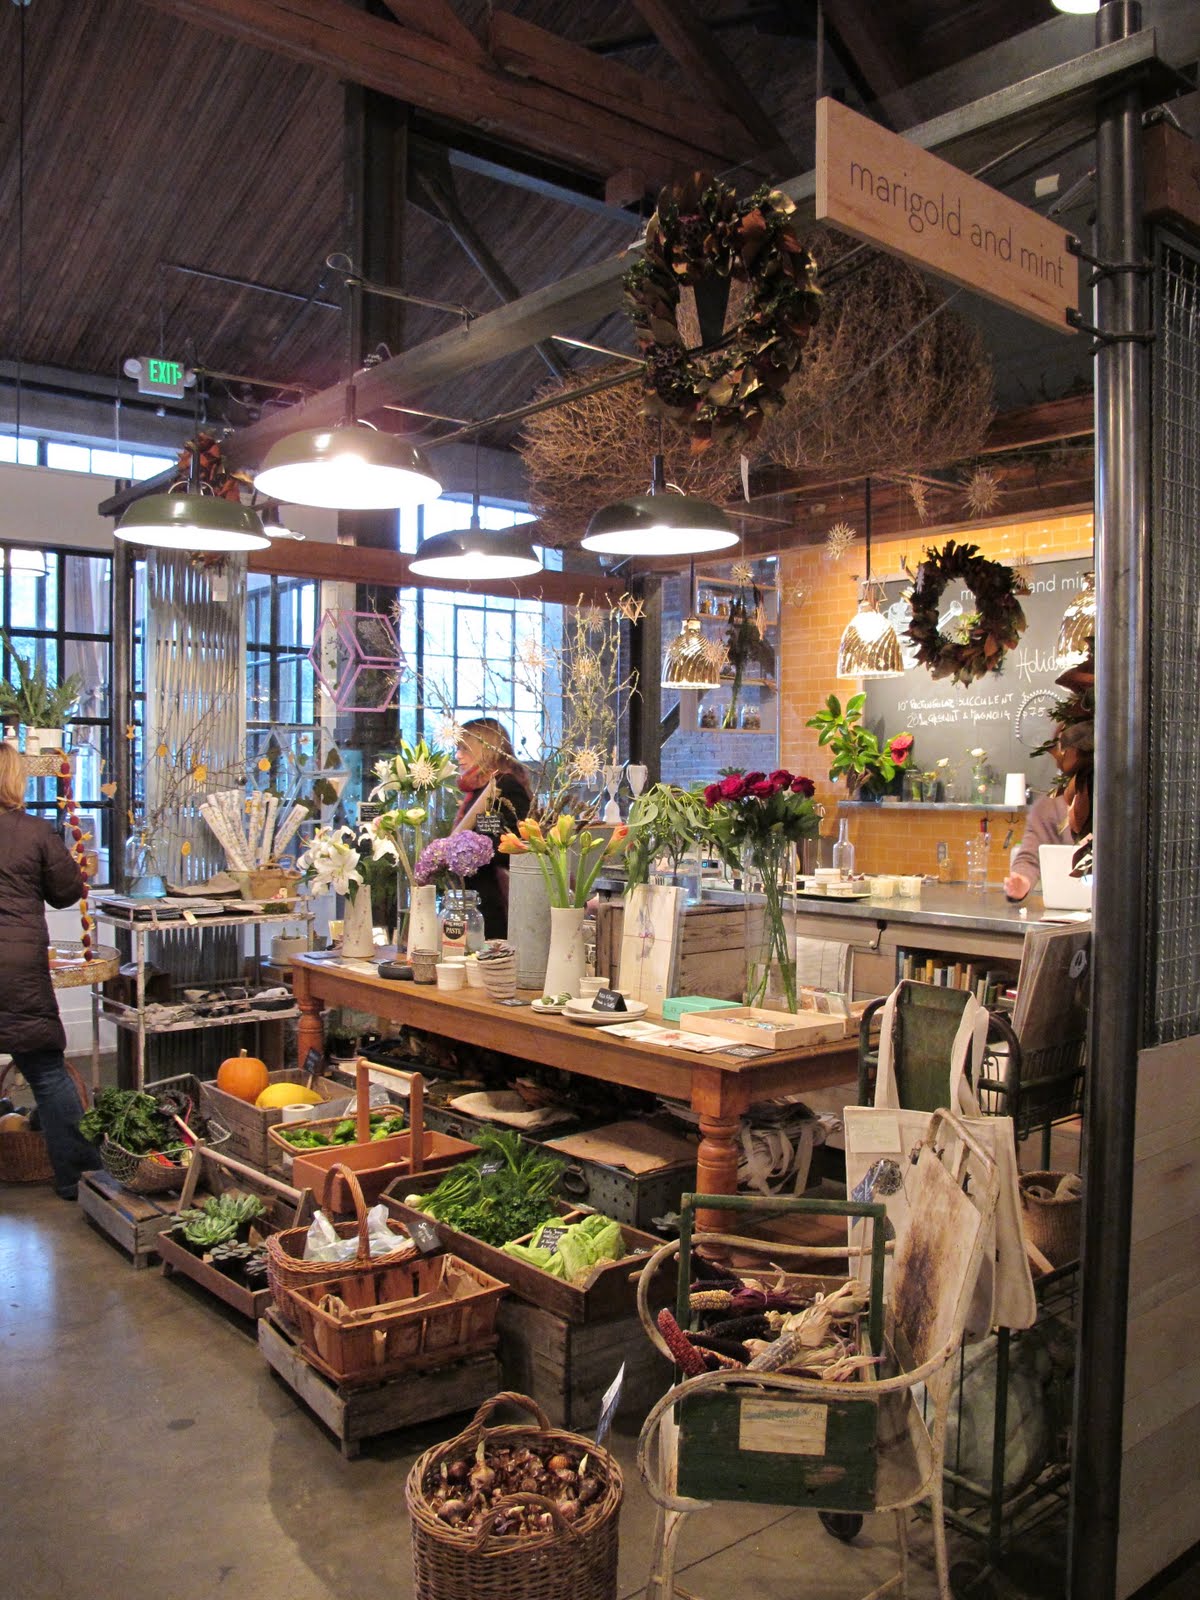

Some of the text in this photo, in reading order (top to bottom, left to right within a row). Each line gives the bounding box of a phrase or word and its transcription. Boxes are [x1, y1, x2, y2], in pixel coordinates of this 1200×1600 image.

[851, 161, 1065, 288] marigold and mint
[149, 359, 179, 385] EXIT
[1028, 574, 1056, 593] and
[958, 692, 1014, 706] SUCCULENT
